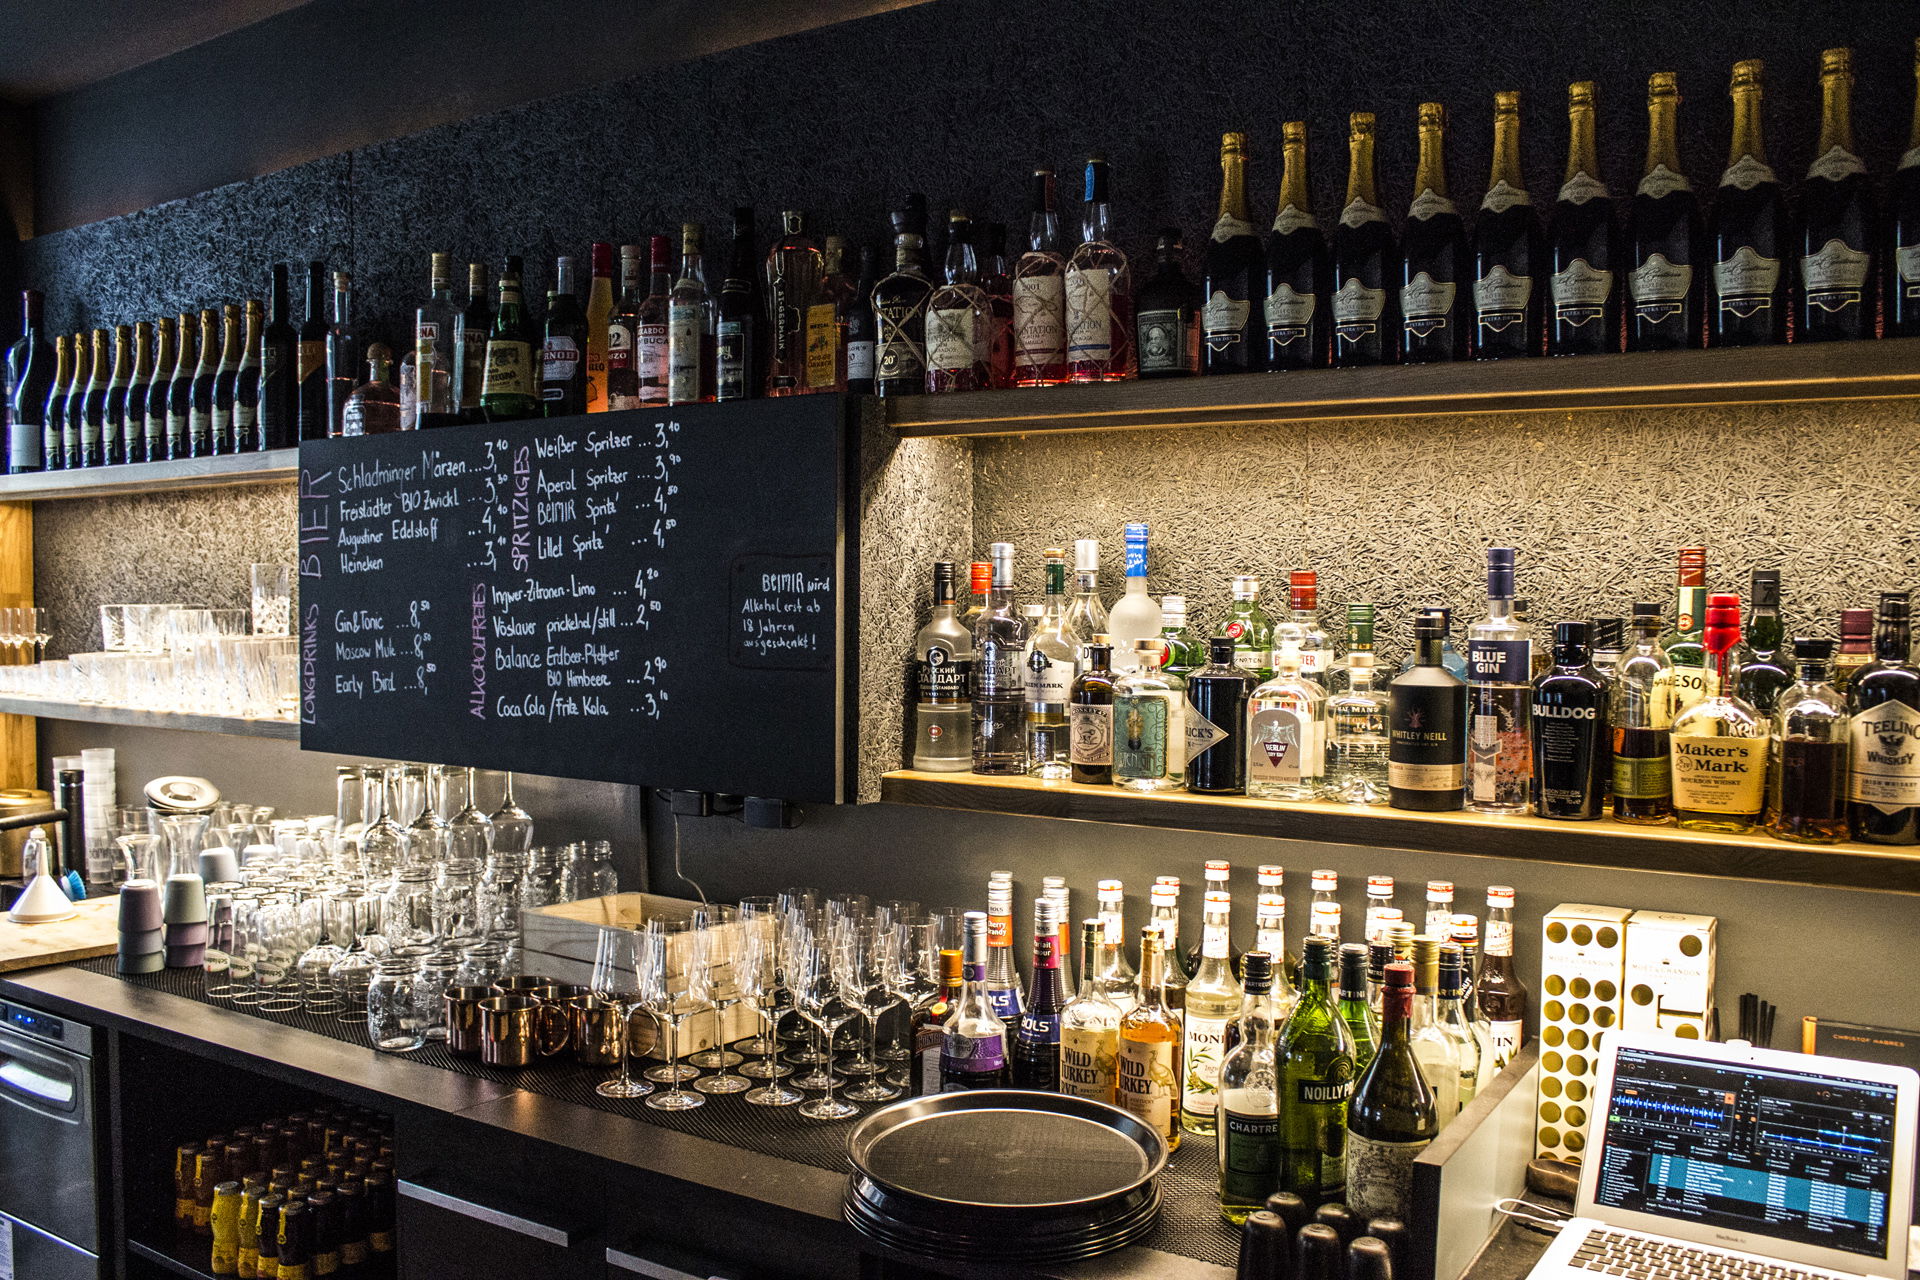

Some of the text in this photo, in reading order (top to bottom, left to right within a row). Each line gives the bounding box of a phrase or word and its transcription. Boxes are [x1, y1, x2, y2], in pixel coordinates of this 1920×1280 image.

[544, 350, 577, 361] RNOD
[535, 434, 578, 460] Weißer
[584, 431, 633, 459] Spritzer
[338, 458, 416, 499] Schladminger
[422, 450, 466, 480] Märzen
[537, 469, 577, 501] Aperol
[586, 465, 628, 492] Spritzer
[401, 490, 421, 513] BIO
[423, 488, 460, 511] Zwickl
[511, 446, 531, 573] SPRITZIGES
[300, 468, 333, 580] BIER
[392, 518, 439, 543] Edelstoff
[537, 535, 564, 560] Lillet
[340, 555, 384, 575] Heineken
[807, 577, 830, 592] wird
[741, 597, 821, 614] Alkohol erst ab
[492, 616, 536, 638] Vöslauer
[743, 618, 795, 639] 18 Jahren
[336, 641, 371, 661] Moscow
[495, 646, 542, 671] Balance
[1472, 651, 1506, 664] BLUE
[302, 603, 319, 726] LONGDRINKS
[1476, 663, 1500, 674] GIN
[335, 674, 364, 700] Early
[372, 670, 397, 694] Bird
[547, 669, 562, 687] BIO
[497, 696, 522, 718] Coca
[523, 694, 546, 717] Cola
[582, 696, 609, 717] Kola
[1532, 704, 1596, 719] BULLDOG
[1391, 729, 1447, 741] WHITLEY NEILL
[1675, 742, 1749, 757] Maker's
[1867, 751, 1915, 766] WHISKEY
[1694, 758, 1749, 773] Mark
[1340, 991, 1365, 999] ARTINI
[1021, 1016, 1051, 1033] BOLS
[1189, 1031, 1224, 1045] MONI
[1064, 1047, 1092, 1068] WILD
[1120, 1055, 1145, 1077] WILD
[1061, 1060, 1099, 1085] TURKEY
[1119, 1075, 1153, 1095] URKEY
[1304, 1084, 1344, 1101] NOILLY
[1229, 1121, 1278, 1134] CHARTRE
